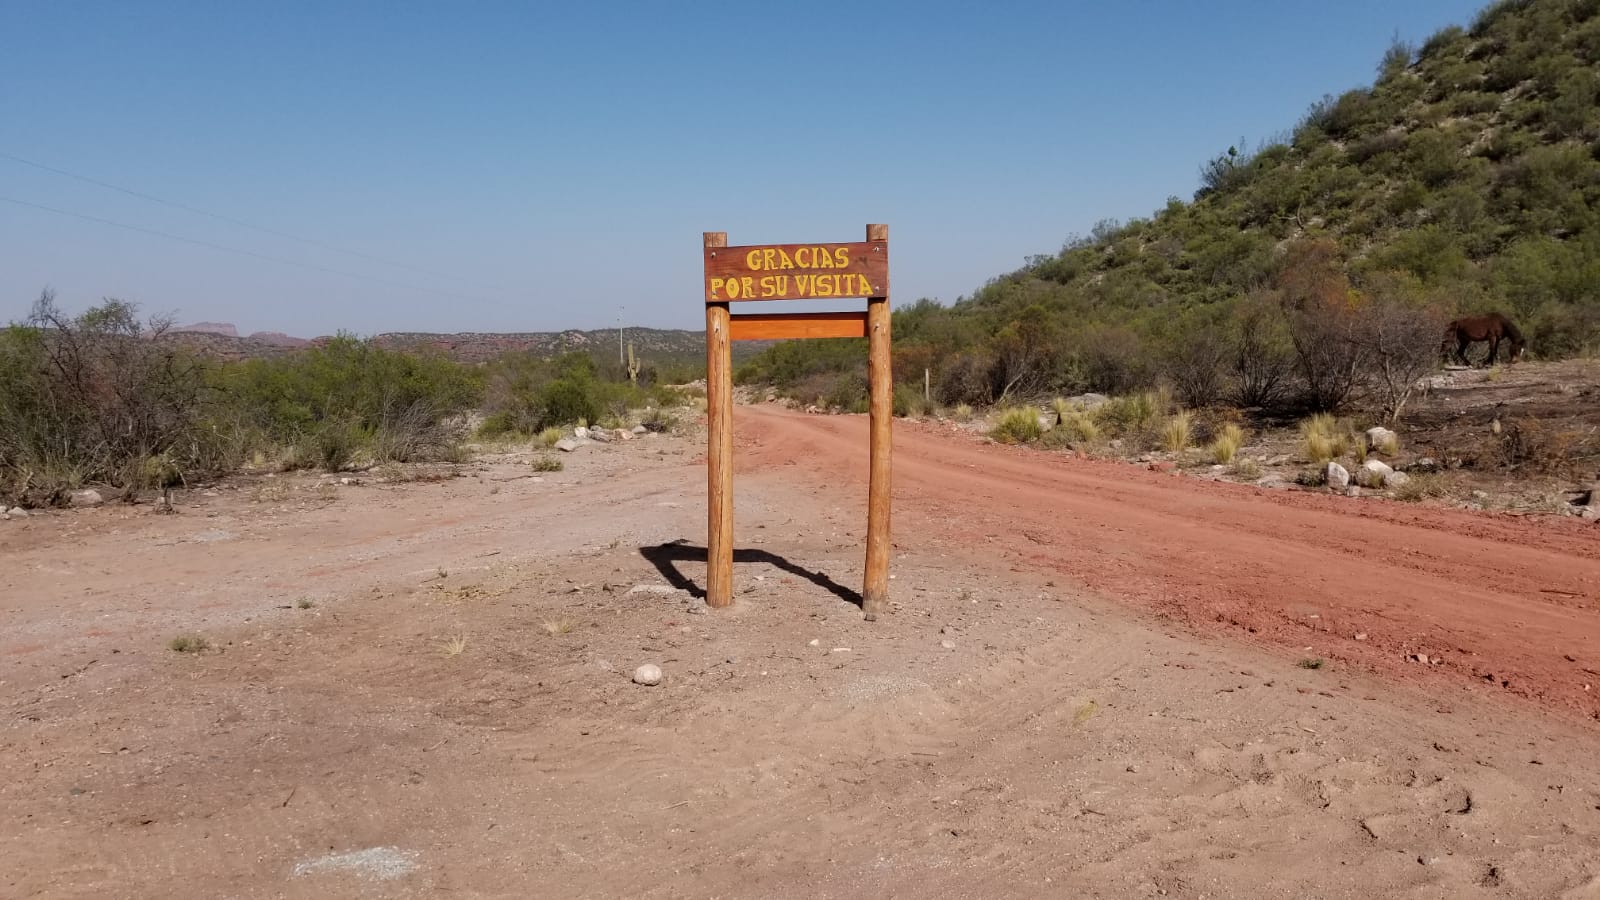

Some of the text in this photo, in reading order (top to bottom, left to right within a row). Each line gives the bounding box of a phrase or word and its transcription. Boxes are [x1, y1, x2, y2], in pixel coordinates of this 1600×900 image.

[746, 247, 850, 271] GRACIAS
[710, 273, 874, 300] POR SU VISITA
